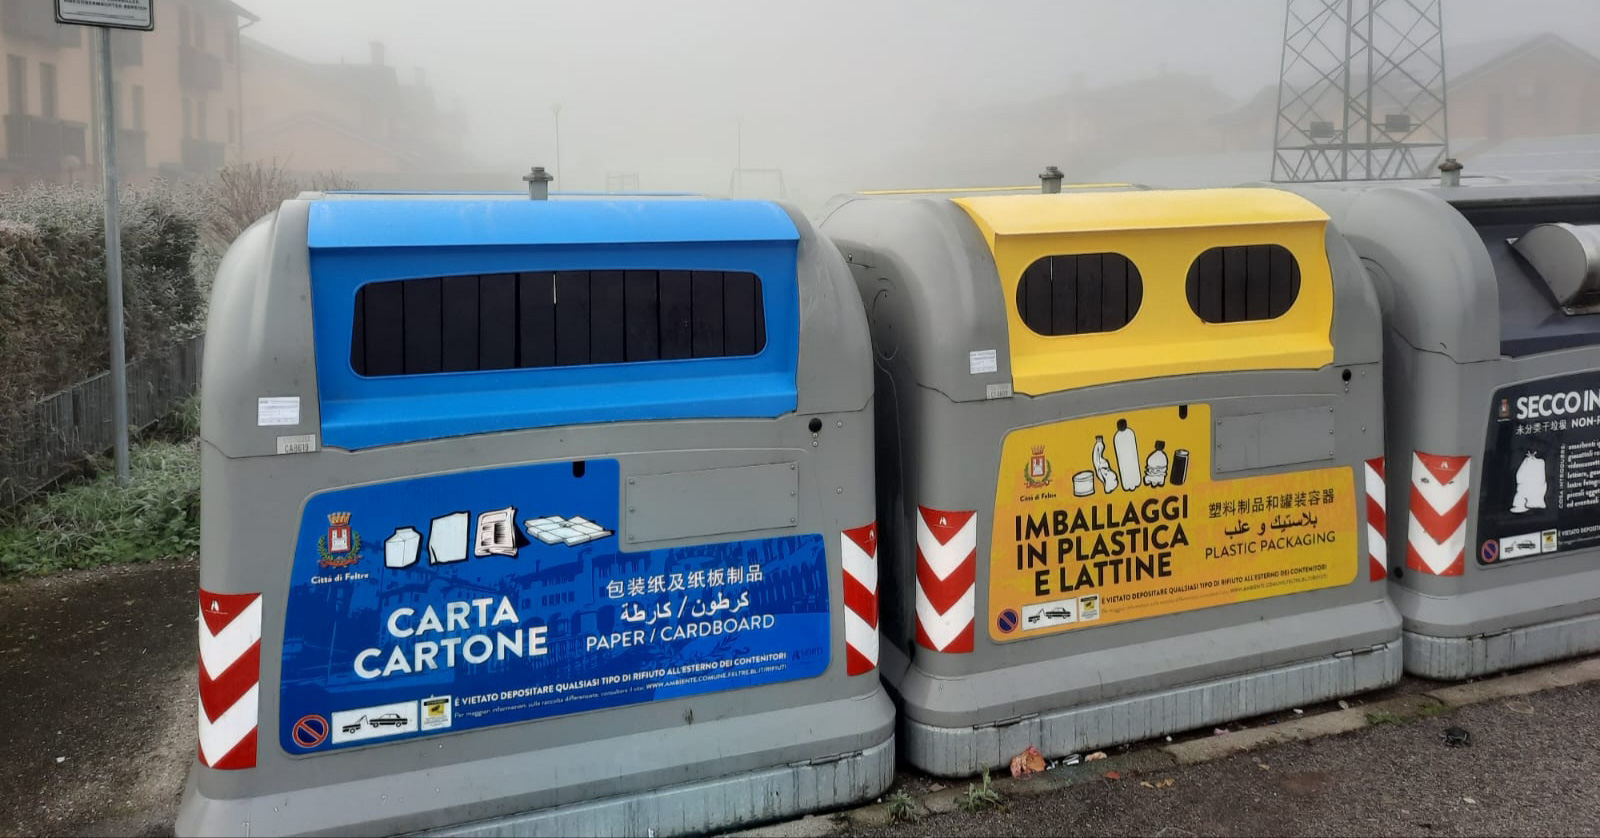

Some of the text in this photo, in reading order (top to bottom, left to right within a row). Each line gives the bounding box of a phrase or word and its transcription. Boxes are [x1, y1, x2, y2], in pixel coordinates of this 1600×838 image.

[1516, 391, 1581, 419] SECCO
[1015, 494, 1188, 541] IMBALLAGGI
[1208, 488, 1335, 518] 塑料制品和罐装容器
[1017, 523, 1189, 570] IN PLASTICA
[1205, 530, 1336, 560] PLASTIC PACKAGING
[1224, 519, 1250, 539] علب
[1257, 522, 1266, 536] و
[334, 573, 343, 581] di
[345, 571, 369, 580] Feltre
[606, 564, 763, 599] 包装纸及纸板制品
[1035, 551, 1172, 597] E LATTINE
[1106, 594, 1131, 603] VIETATO
[1132, 588, 1167, 599] DEPOSITARE
[1168, 584, 1199, 595] QUALSIASI
[1221, 577, 1243, 585] RIFIUTO
[1244, 571, 1279, 582] ALL'ESTERNO
[1290, 564, 1327, 575] CONTENITORI
[387, 595, 519, 638] CARTA
[620, 591, 750, 625] كرطون / كارطة
[586, 614, 775, 652] PAPER / CARDBOARD
[354, 625, 548, 679] CARTONE
[462, 693, 499, 705] VIETATO
[500, 684, 554, 700] DEPOSITARE
[555, 678, 600, 693] QUALSIASI
[602, 675, 621, 686] TIPO
[622, 673, 631, 682] DI
[633, 669, 665, 681] RIFIUTO
[667, 661, 718, 676] ALL'ESTERNO
[719, 658, 733, 668] DEI
[734, 652, 787, 666] CONTENITORI
